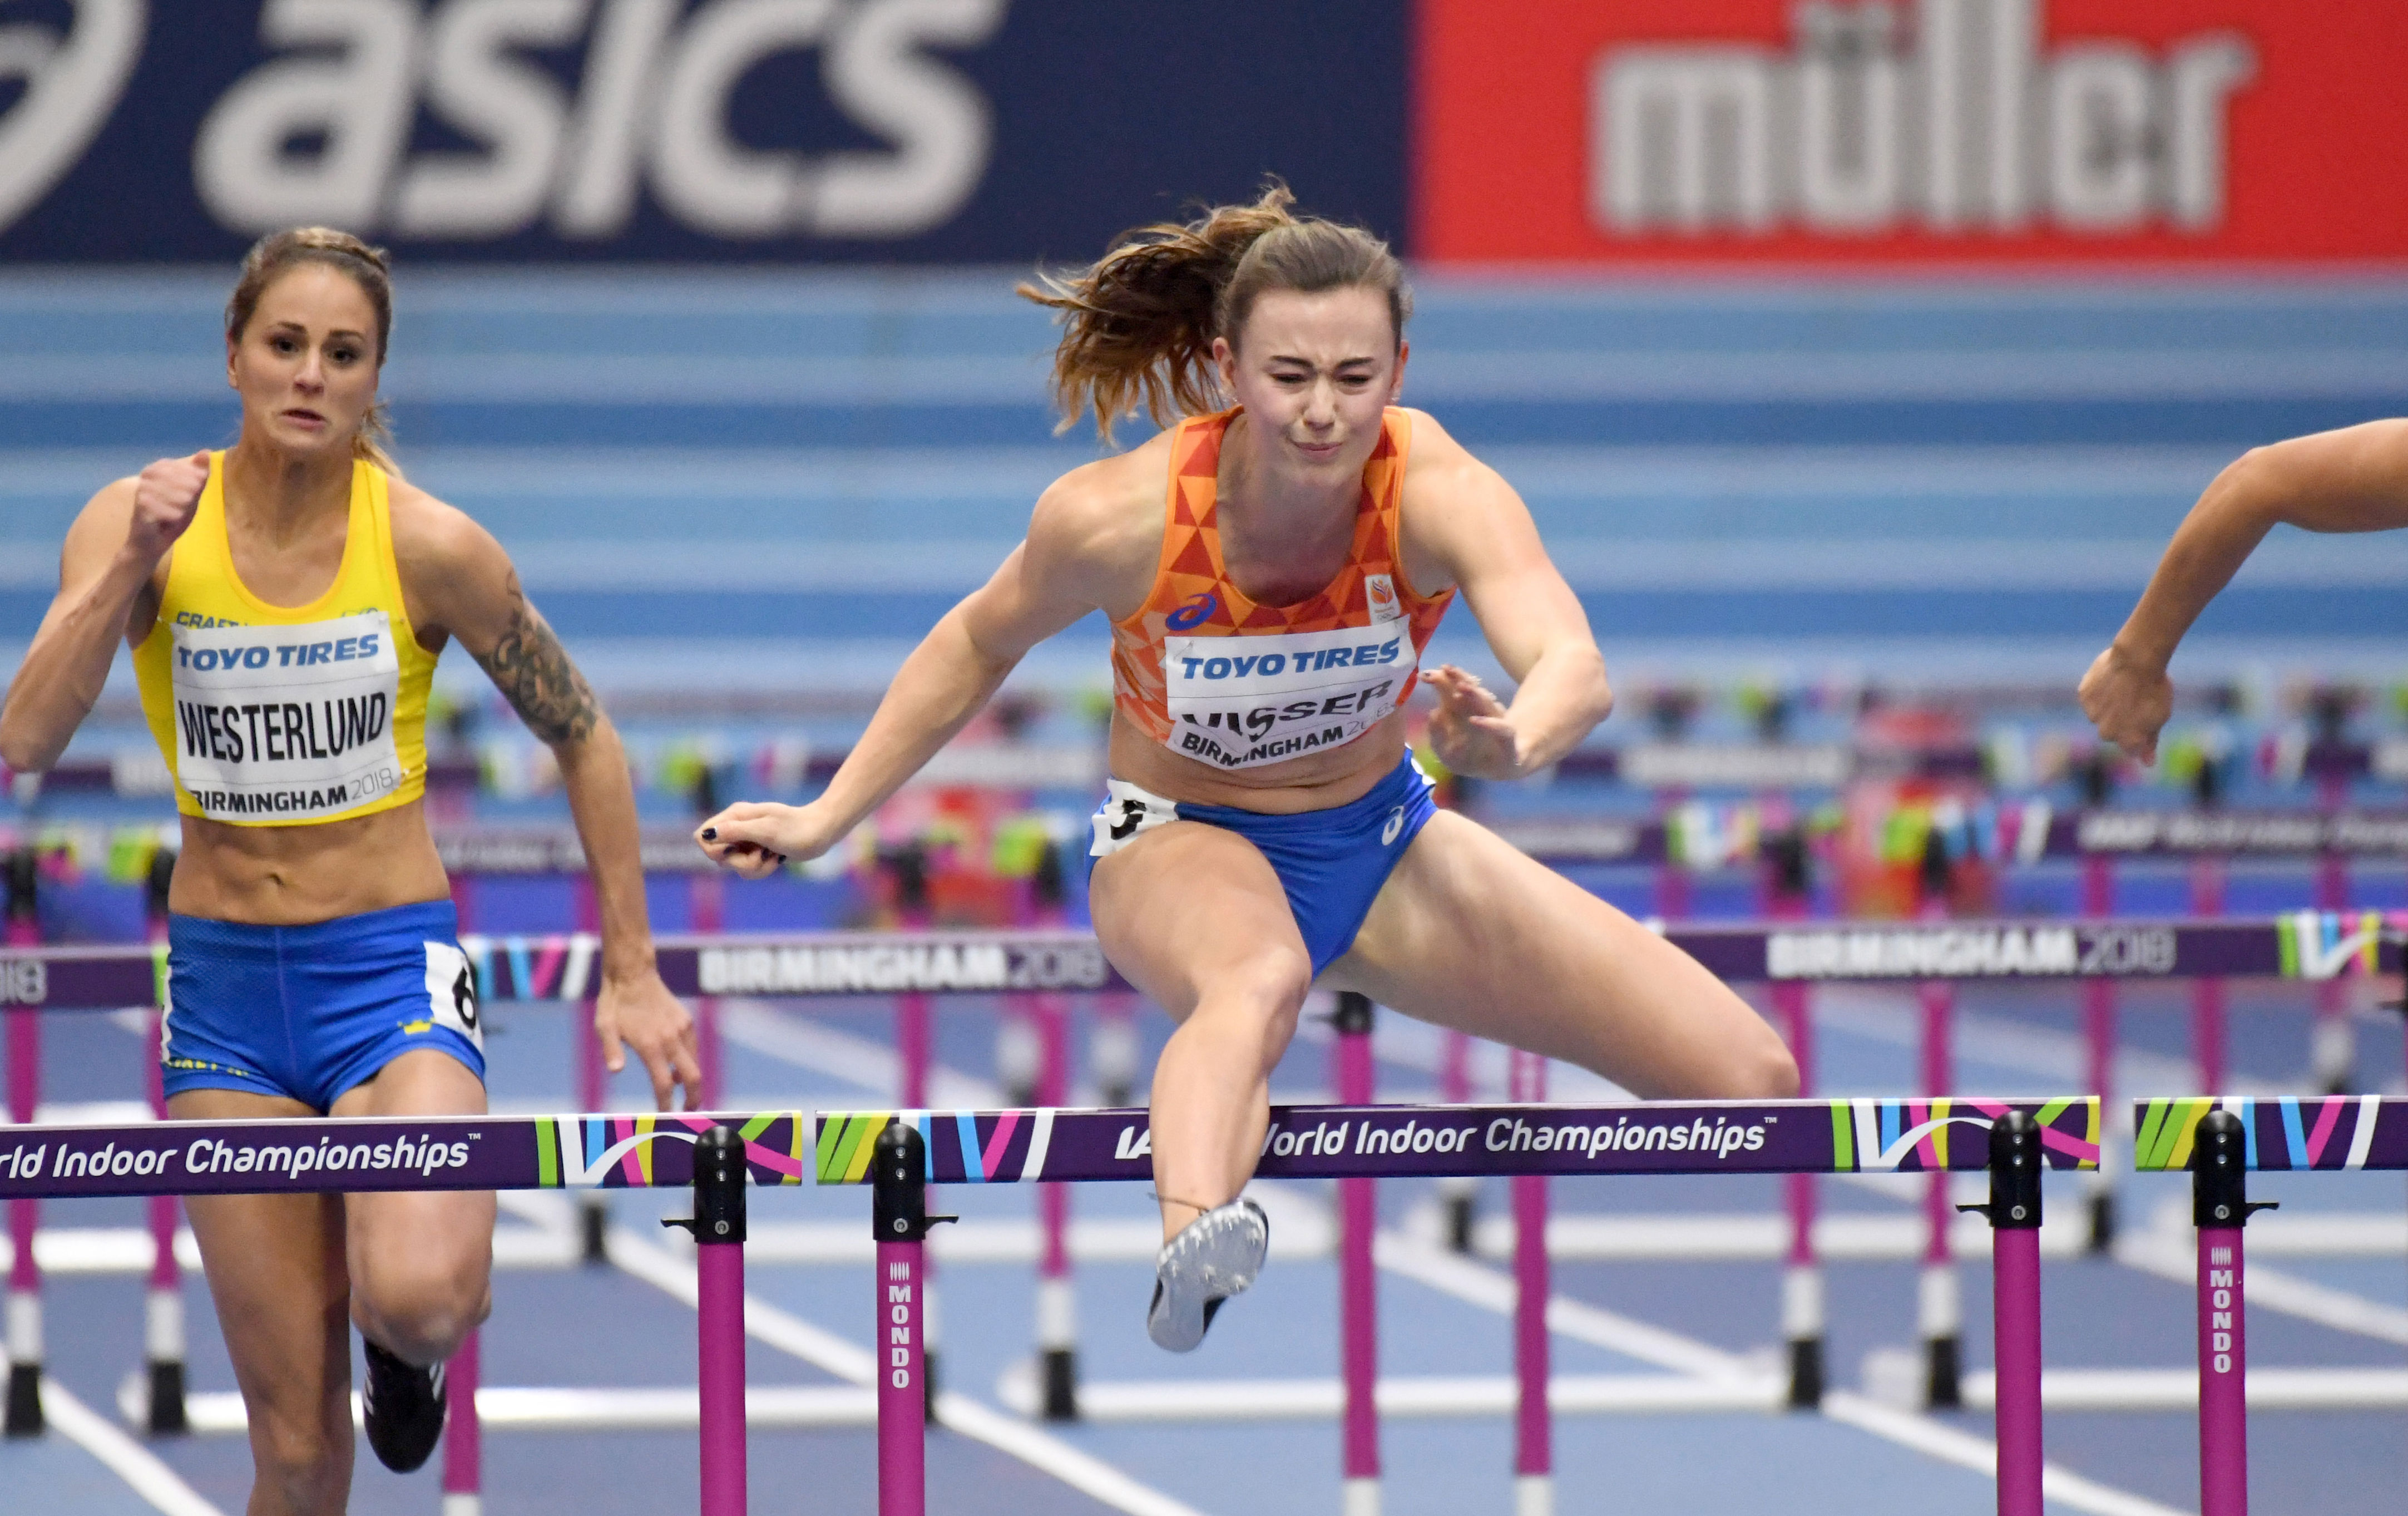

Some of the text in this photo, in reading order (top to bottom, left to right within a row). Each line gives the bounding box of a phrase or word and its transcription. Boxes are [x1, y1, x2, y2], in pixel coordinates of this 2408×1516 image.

[195, 0, 1007, 239] asics
[178, 634, 378, 671] TOYO TIRES
[1181, 637, 1401, 680] TOYO TIRES
[178, 692, 387, 763] WESTERLUND
[1181, 726, 1343, 767] BIRMINGHAM
[352, 768, 393, 800] 2018
[699, 946, 1006, 994] BIRMINGHAM
[1768, 930, 2079, 977] BIRMINGHAM
[452, 966, 476, 1029] 6
[52, 1142, 179, 1177] Indoor
[1355, 1120, 1478, 1154] Indoor
[889, 1285, 911, 1389] MONDO
[2211, 1270, 2233, 1374] MONDO
